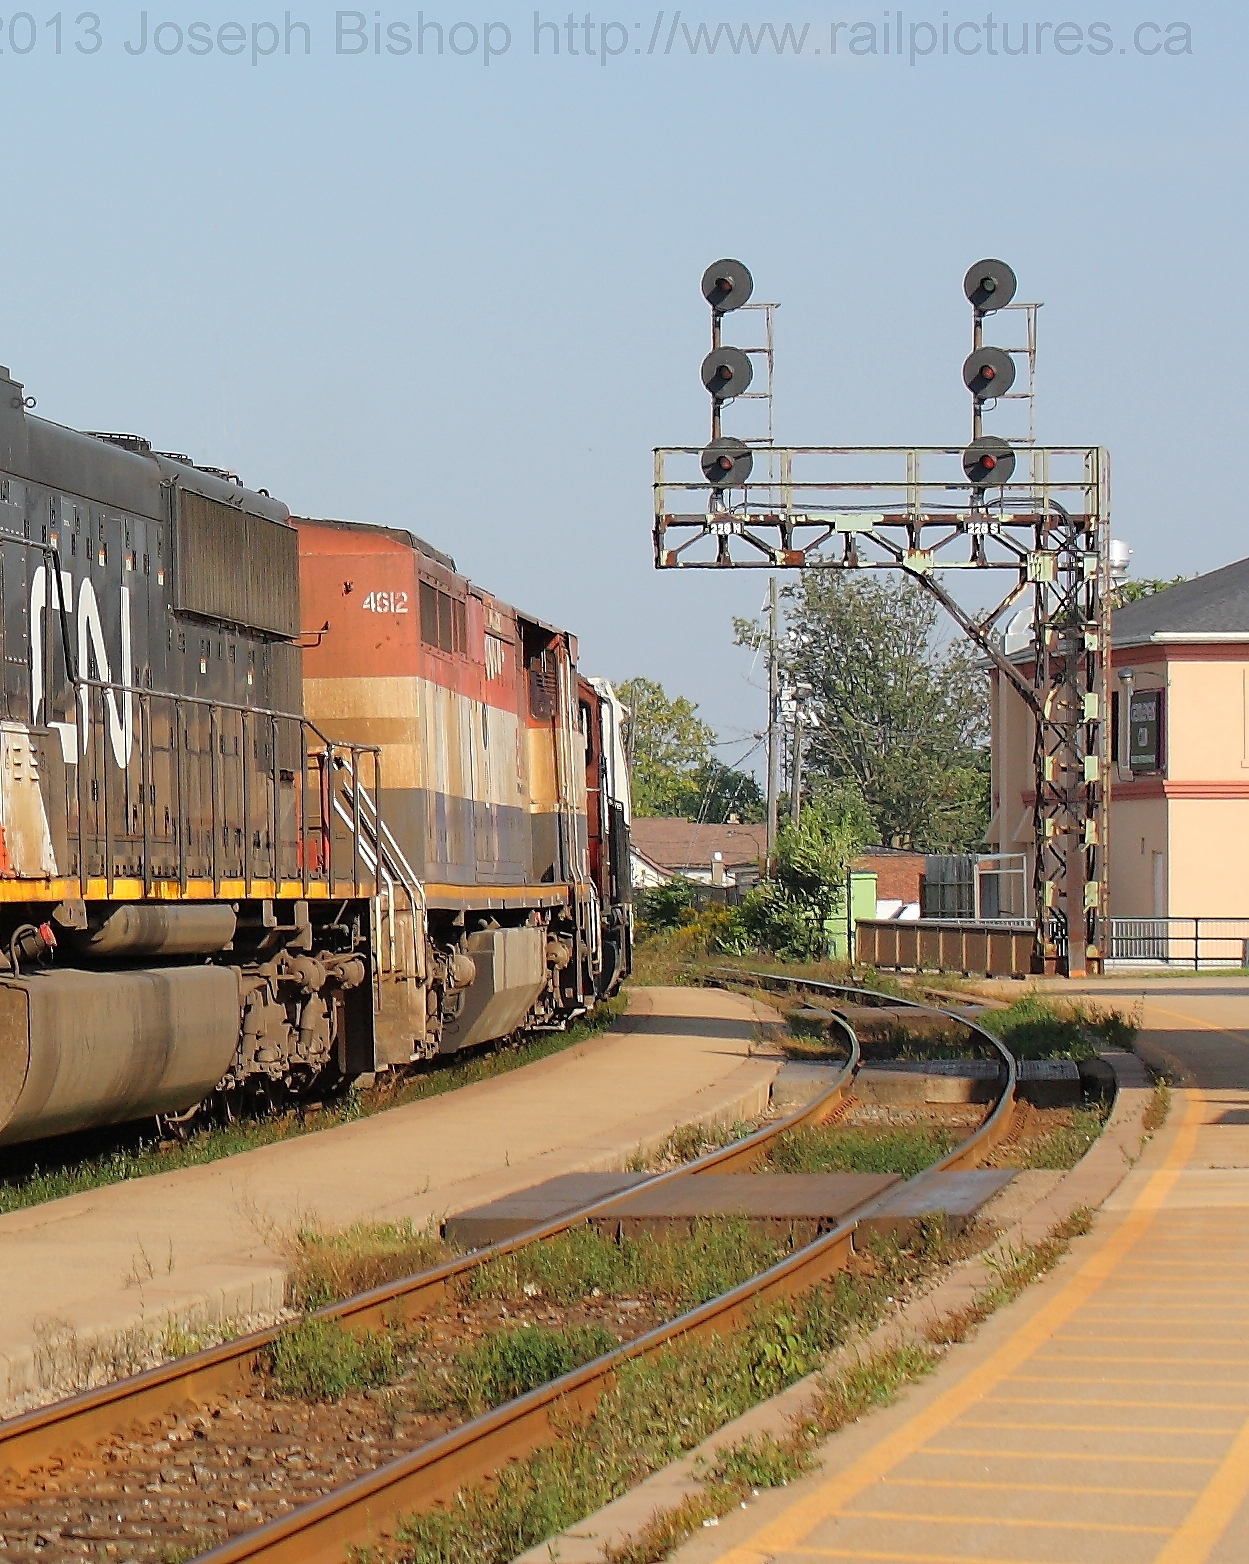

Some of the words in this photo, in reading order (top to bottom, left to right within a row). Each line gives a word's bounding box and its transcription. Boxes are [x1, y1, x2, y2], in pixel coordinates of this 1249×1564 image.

[967, 522, 989, 534] 228
[990, 522, 999, 534] S
[362, 591, 409, 613] 4612
[30, 565, 133, 770] CN
